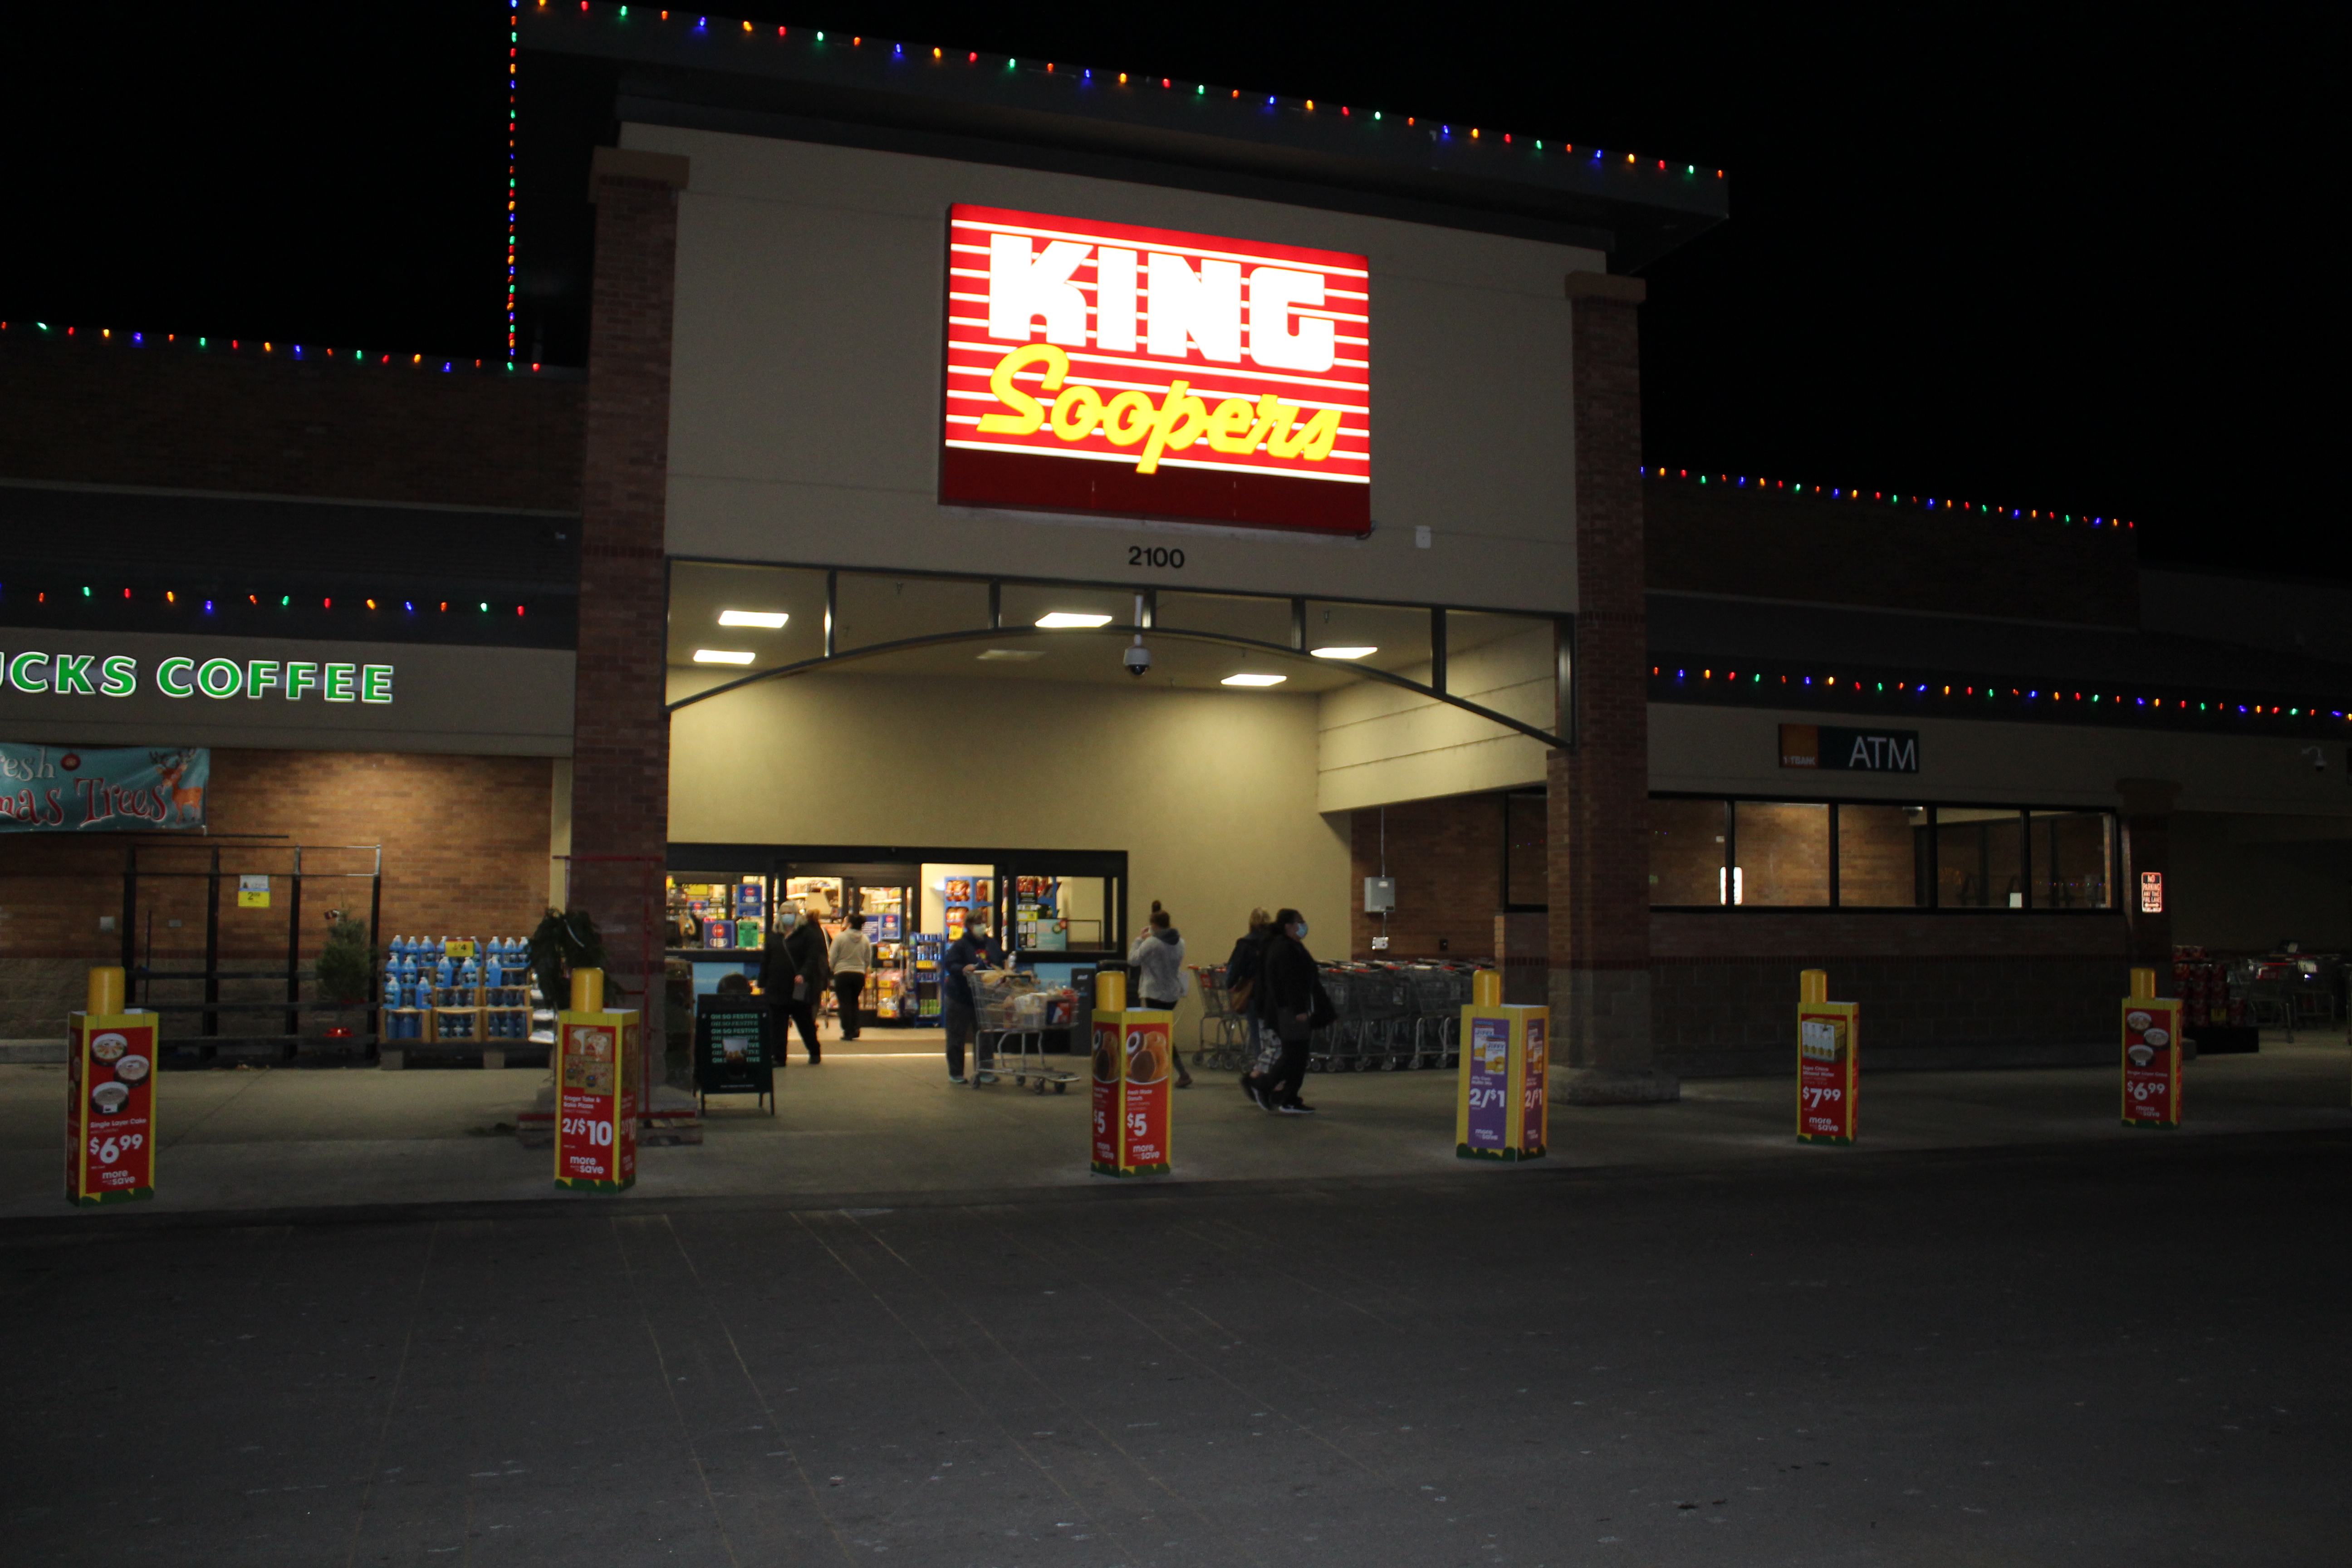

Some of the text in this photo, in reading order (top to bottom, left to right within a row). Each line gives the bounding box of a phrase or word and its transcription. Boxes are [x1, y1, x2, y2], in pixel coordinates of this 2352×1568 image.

[989, 233, 1335, 372] KING
[976, 343, 1342, 474] Soopers
[1128, 546, 1185, 568] 2100
[156, 656, 394, 704] COFFEE
[1848, 735, 1916, 770] ATM
[74, 777, 167, 828] Trees
[1469, 1088, 1505, 1108] 2/$1
[562, 1117, 612, 1146] 2/$10
[1127, 1112, 1147, 1137] $5
[1133, 1144, 1154, 1153] more
[570, 1156, 596, 1165] more
[580, 1165, 604, 1174] save
[103, 1170, 128, 1179] more
[113, 1176, 136, 1185] save
